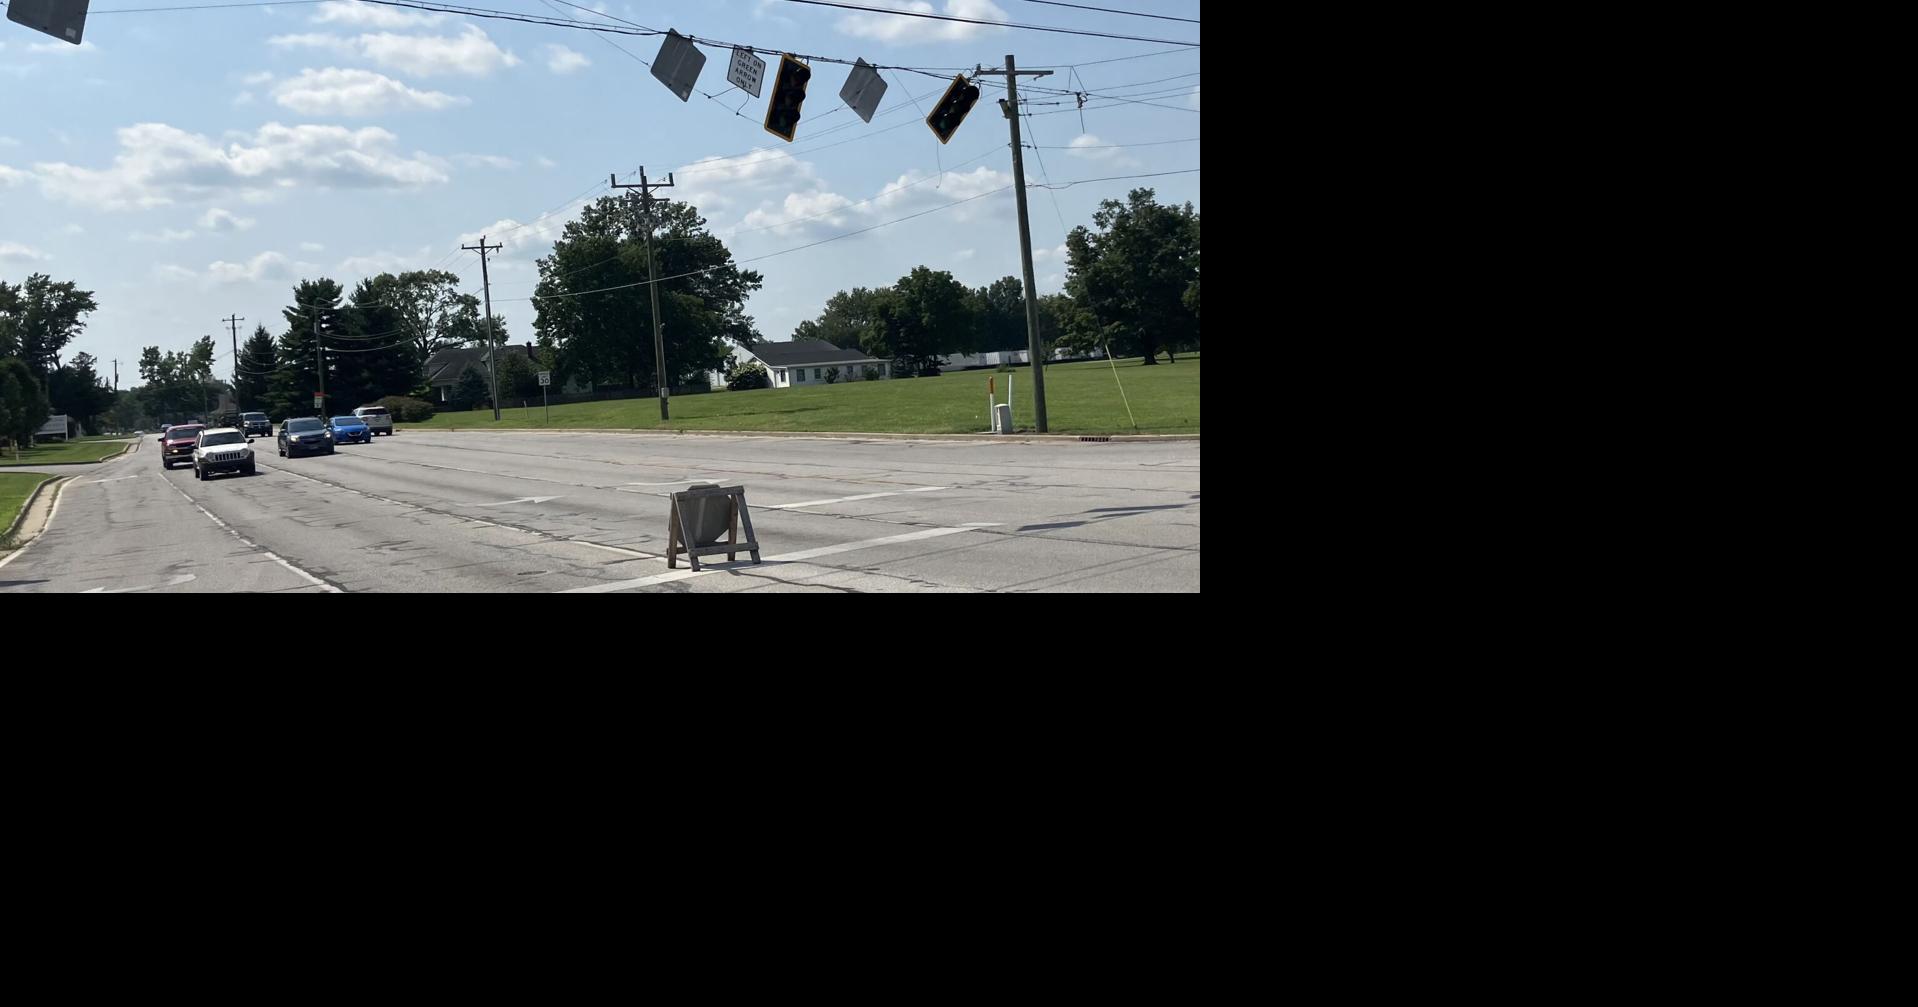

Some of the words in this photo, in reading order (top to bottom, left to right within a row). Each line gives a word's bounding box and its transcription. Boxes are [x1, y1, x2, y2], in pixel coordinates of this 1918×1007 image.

[736, 51, 751, 62] LEFT
[753, 60, 762, 69] ON
[737, 60, 757, 75] GREEN
[735, 67, 757, 82] ARROW
[736, 76, 752, 89] ONLY
